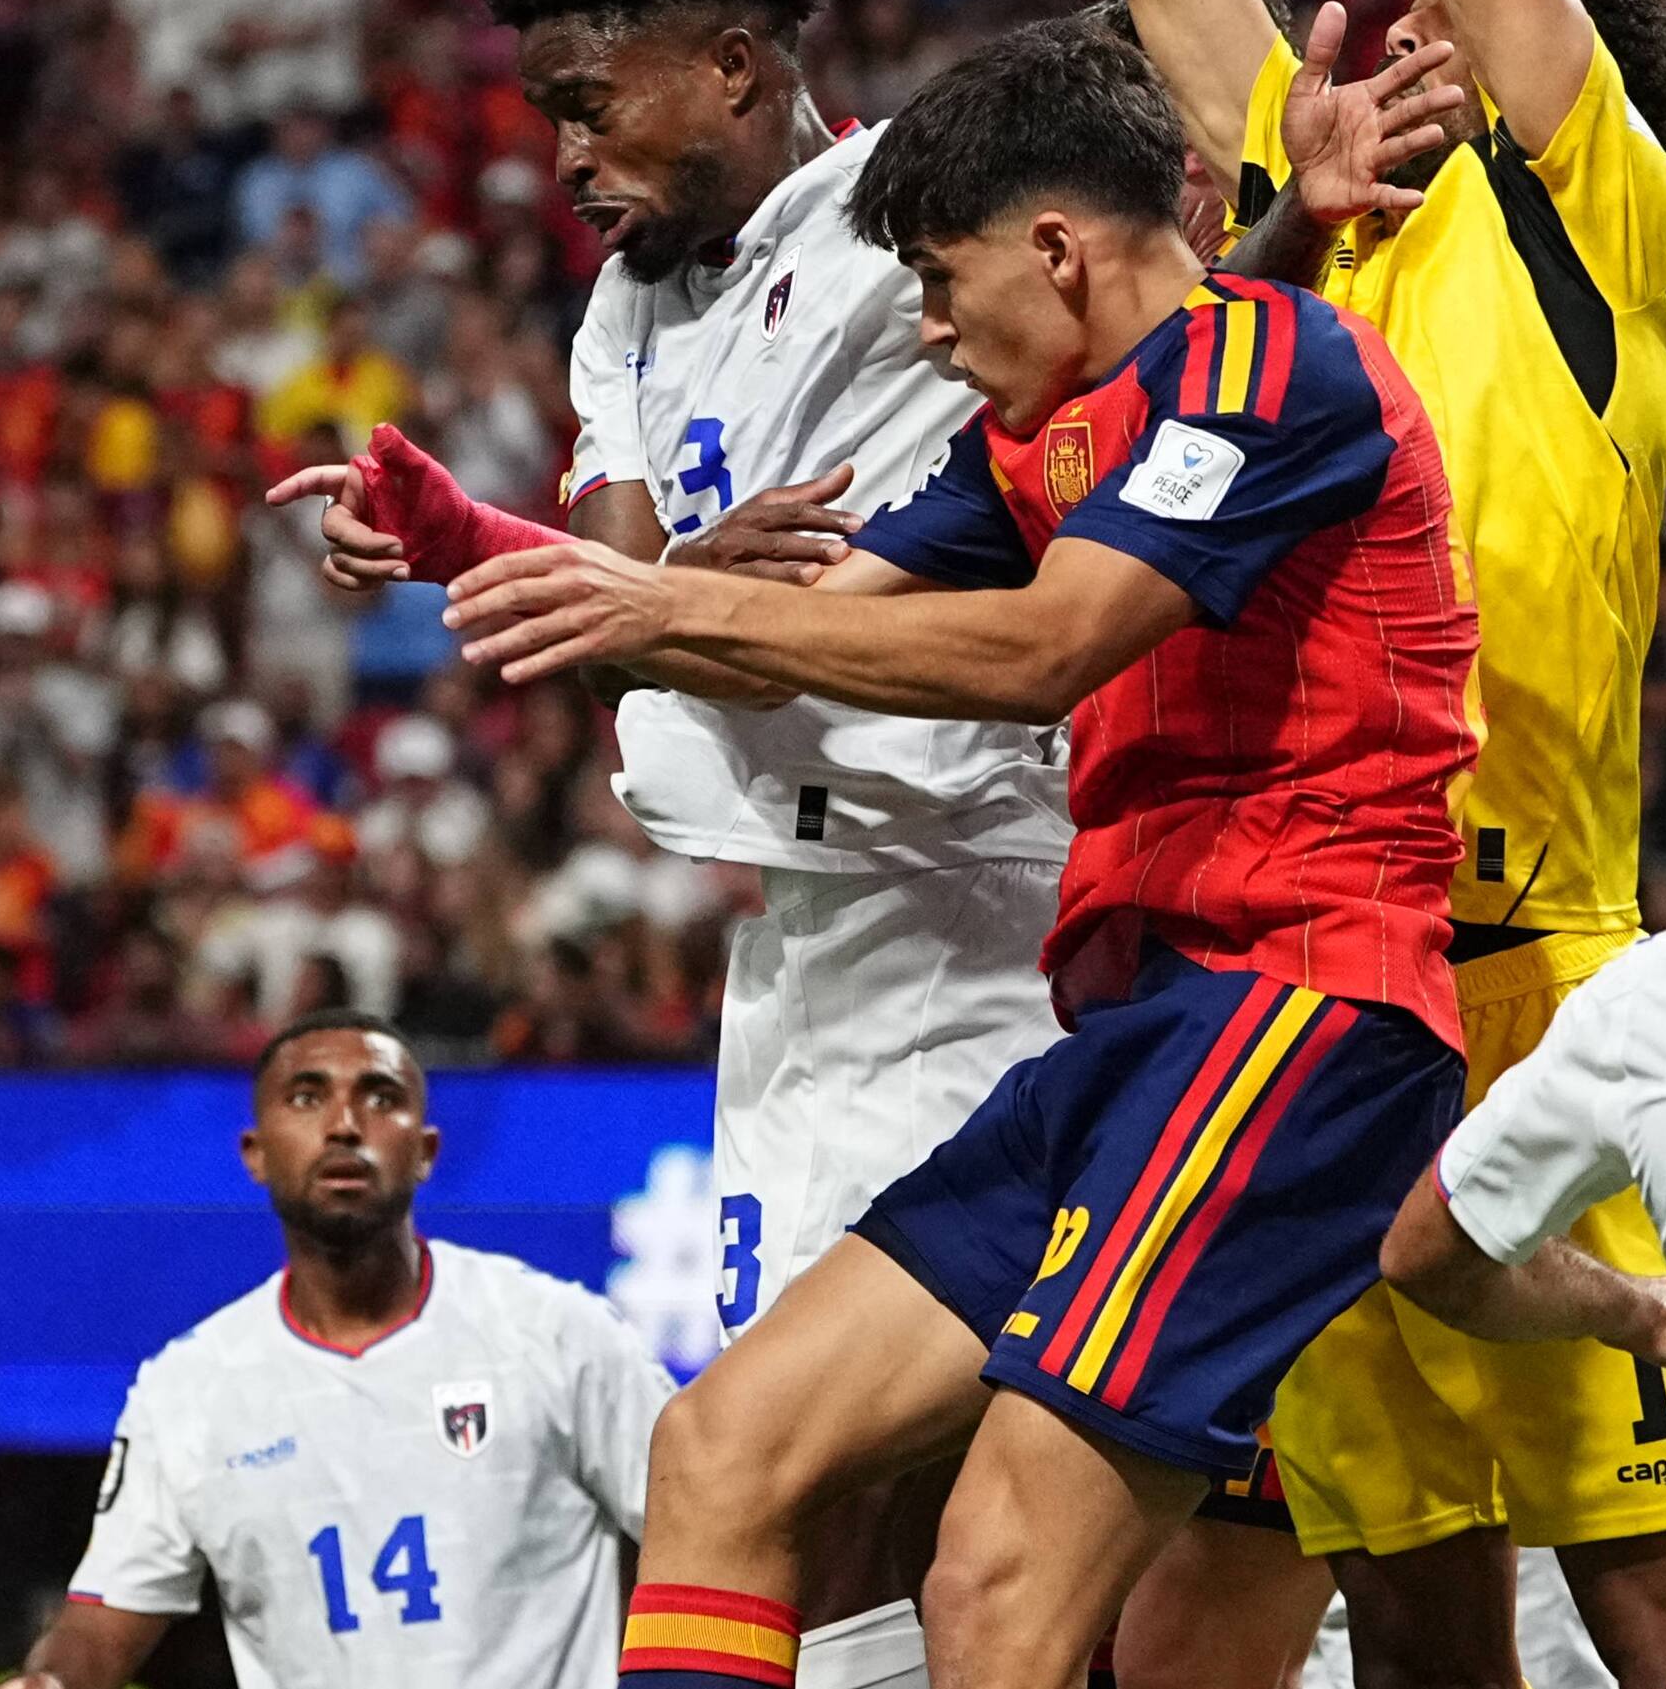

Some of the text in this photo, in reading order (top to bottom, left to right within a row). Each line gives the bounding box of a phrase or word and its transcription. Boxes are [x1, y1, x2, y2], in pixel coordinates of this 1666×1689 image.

[1152, 476, 1193, 505] PEACE
[1152, 493, 1175, 509] FIFA
[716, 1193, 762, 1329] 3
[308, 1515, 441, 1633] 14
